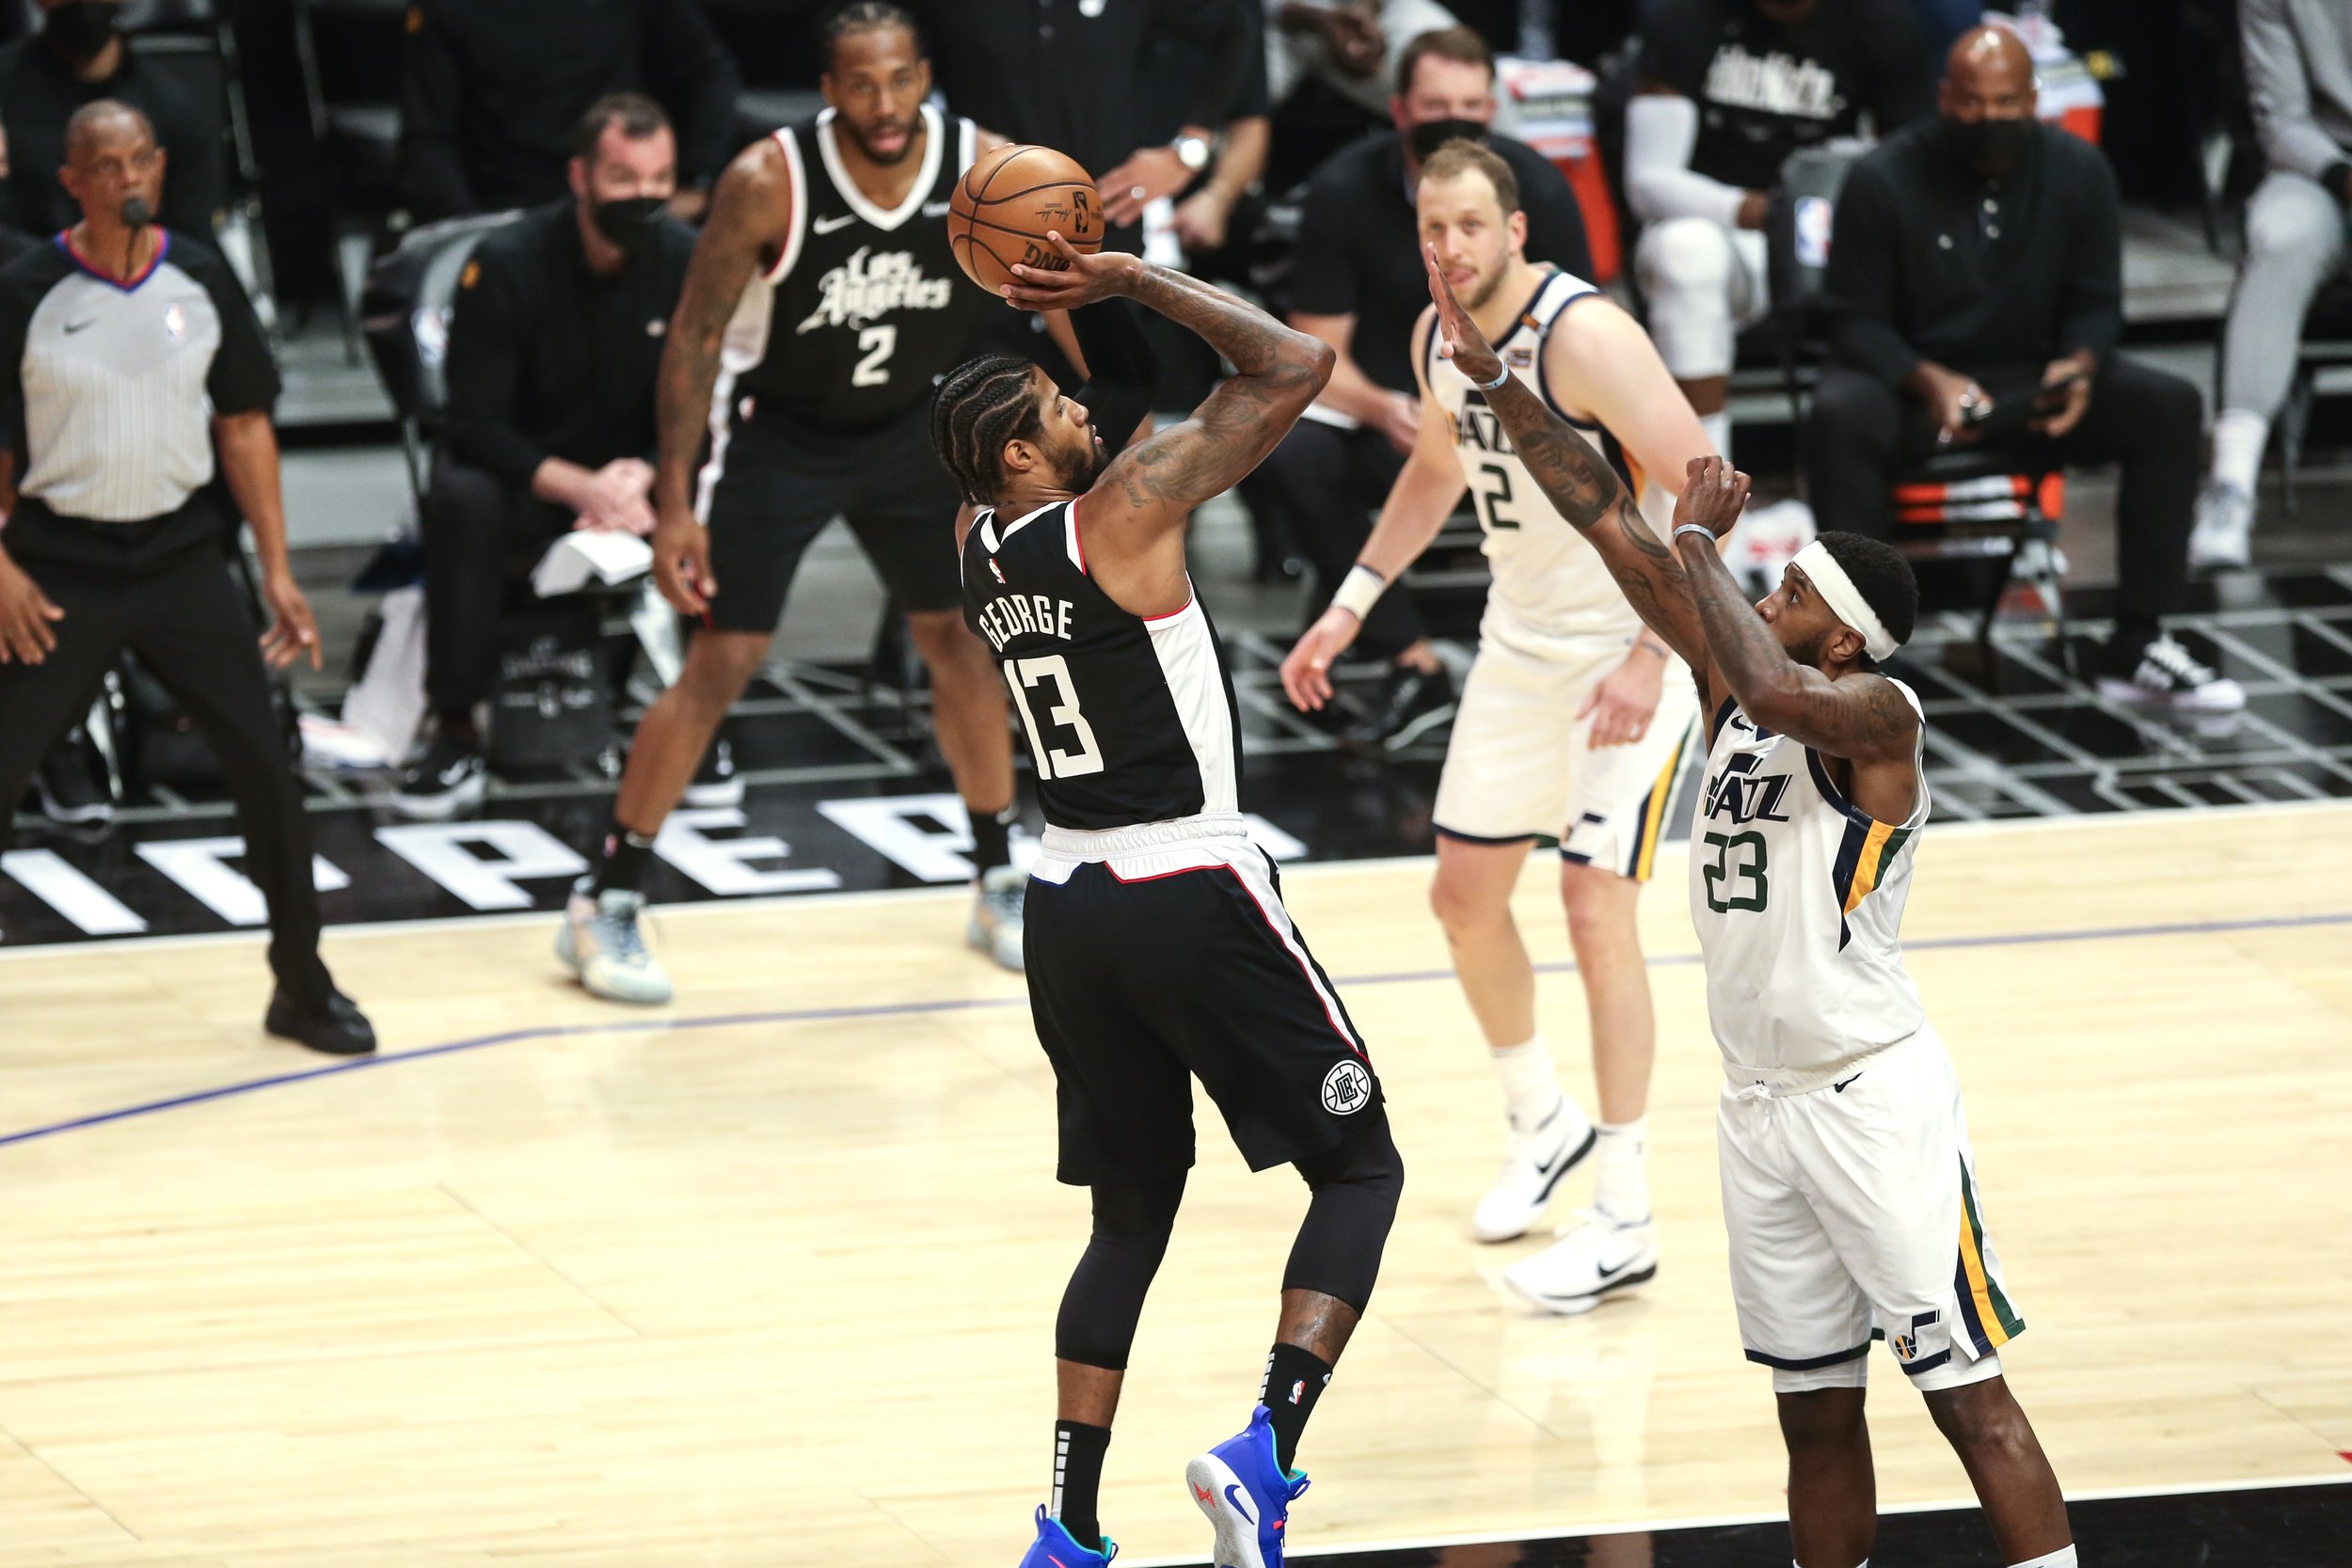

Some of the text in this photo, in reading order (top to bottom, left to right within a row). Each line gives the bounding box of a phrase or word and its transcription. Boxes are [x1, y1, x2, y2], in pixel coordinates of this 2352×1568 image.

[847, 245, 916, 284] Los
[796, 266, 952, 335] Angeles
[851, 324, 898, 388] 2
[1480, 463, 1520, 530] 2
[978, 594, 1074, 654] GEORGE
[1003, 654, 1104, 781] 13
[1702, 830, 1769, 914] 23
